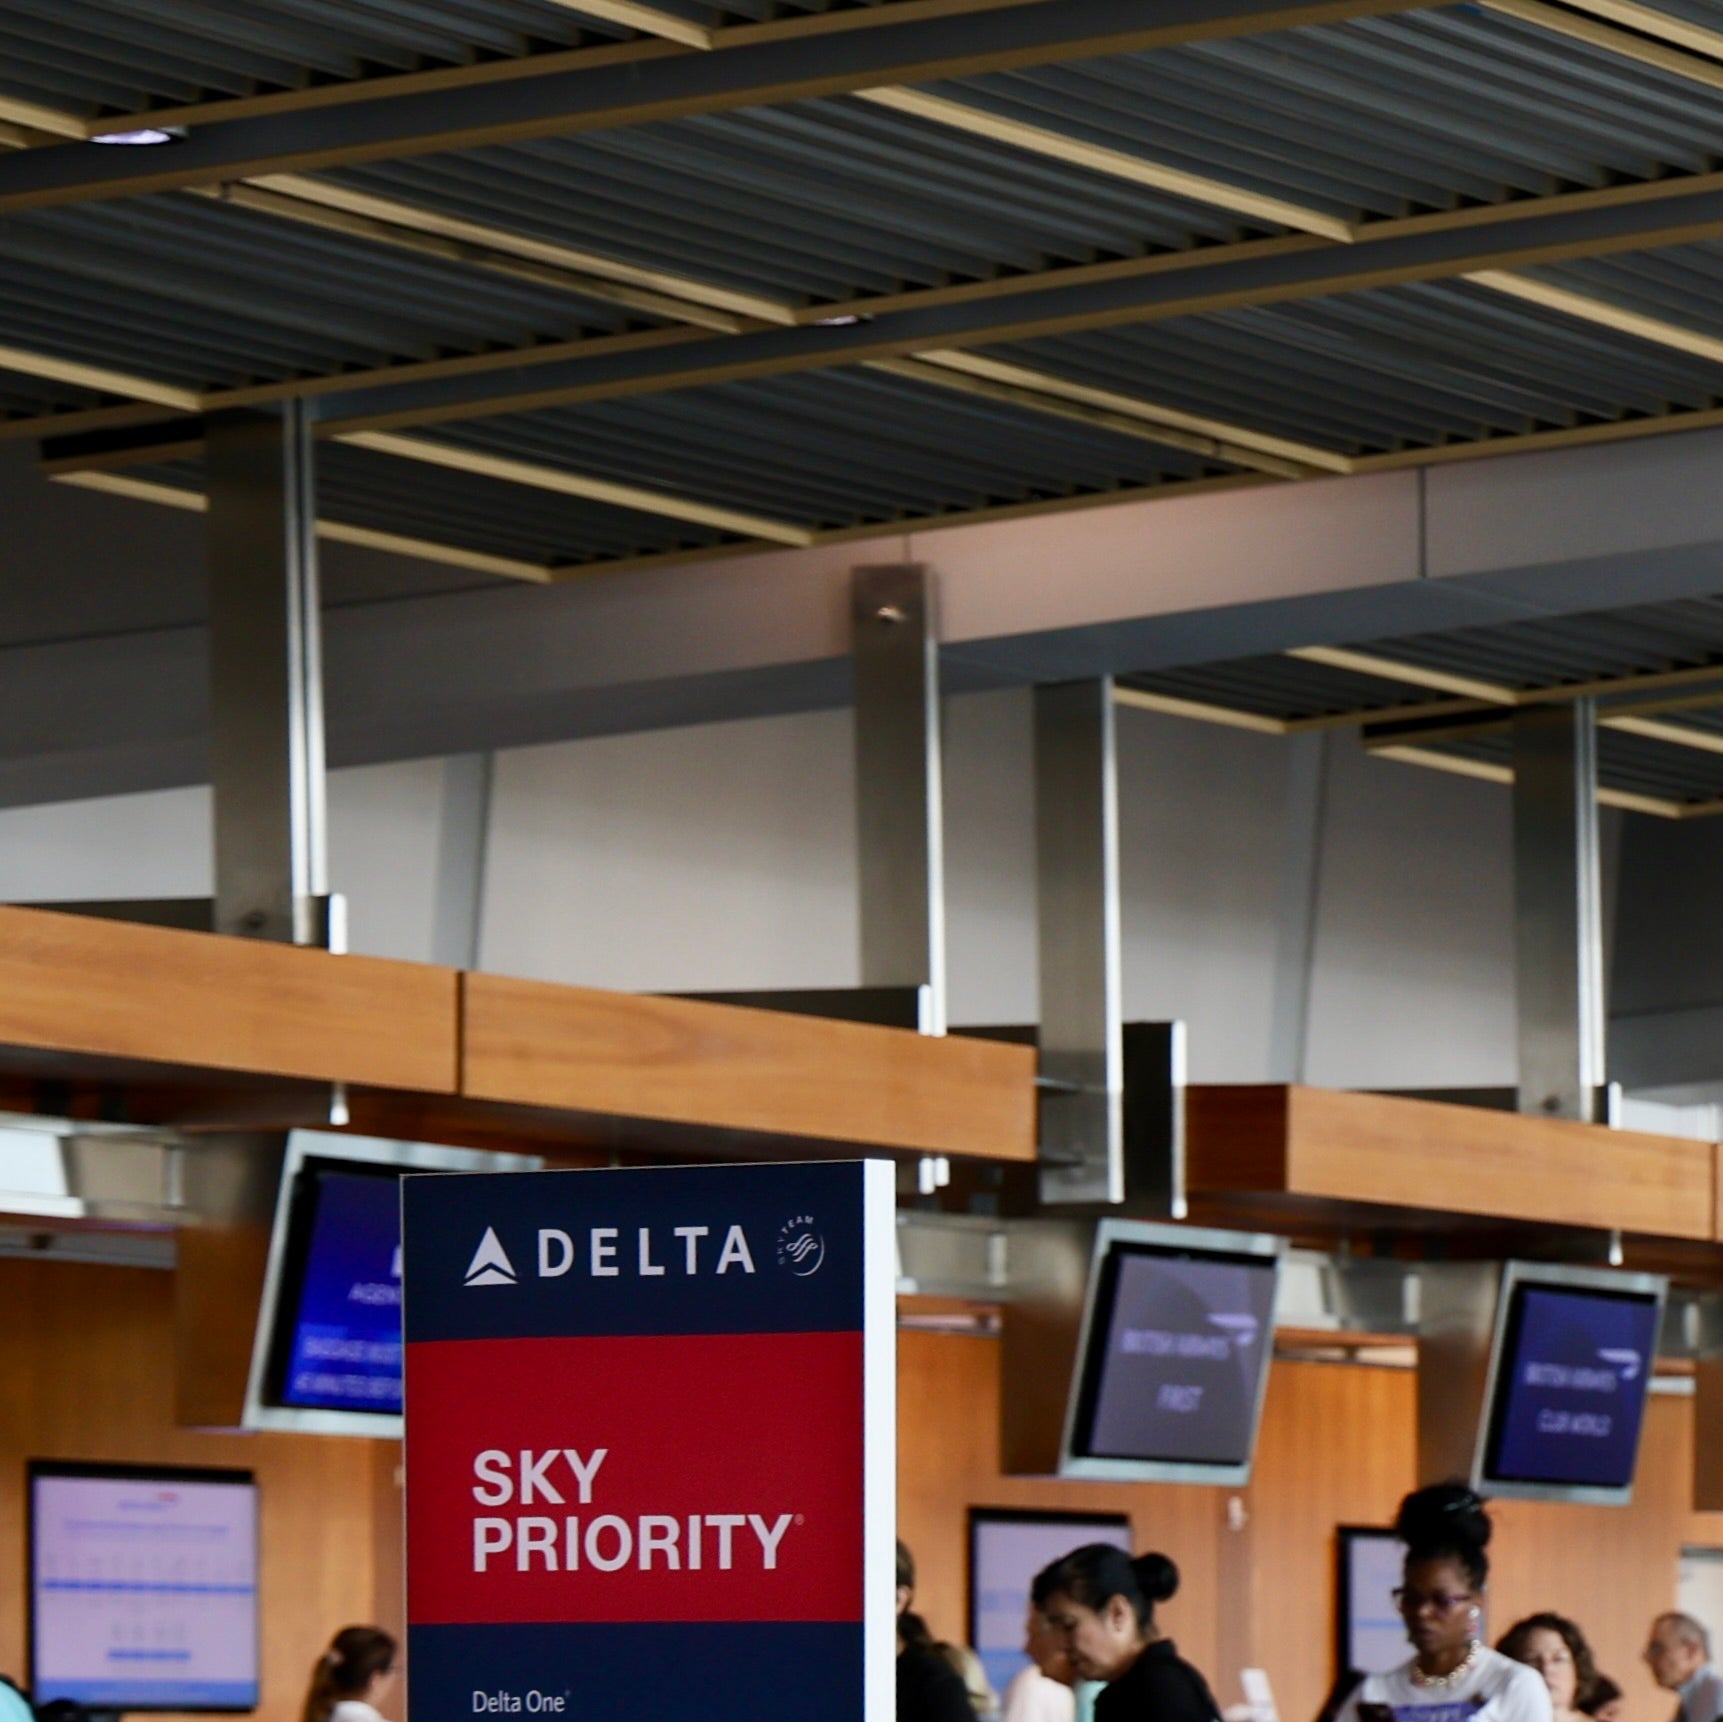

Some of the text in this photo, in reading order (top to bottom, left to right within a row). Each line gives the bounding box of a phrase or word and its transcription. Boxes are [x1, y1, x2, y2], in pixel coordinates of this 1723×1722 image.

[538, 1225, 755, 1277] DELTA
[473, 1449, 608, 1506] SKY
[473, 1690, 521, 1712] Delta
